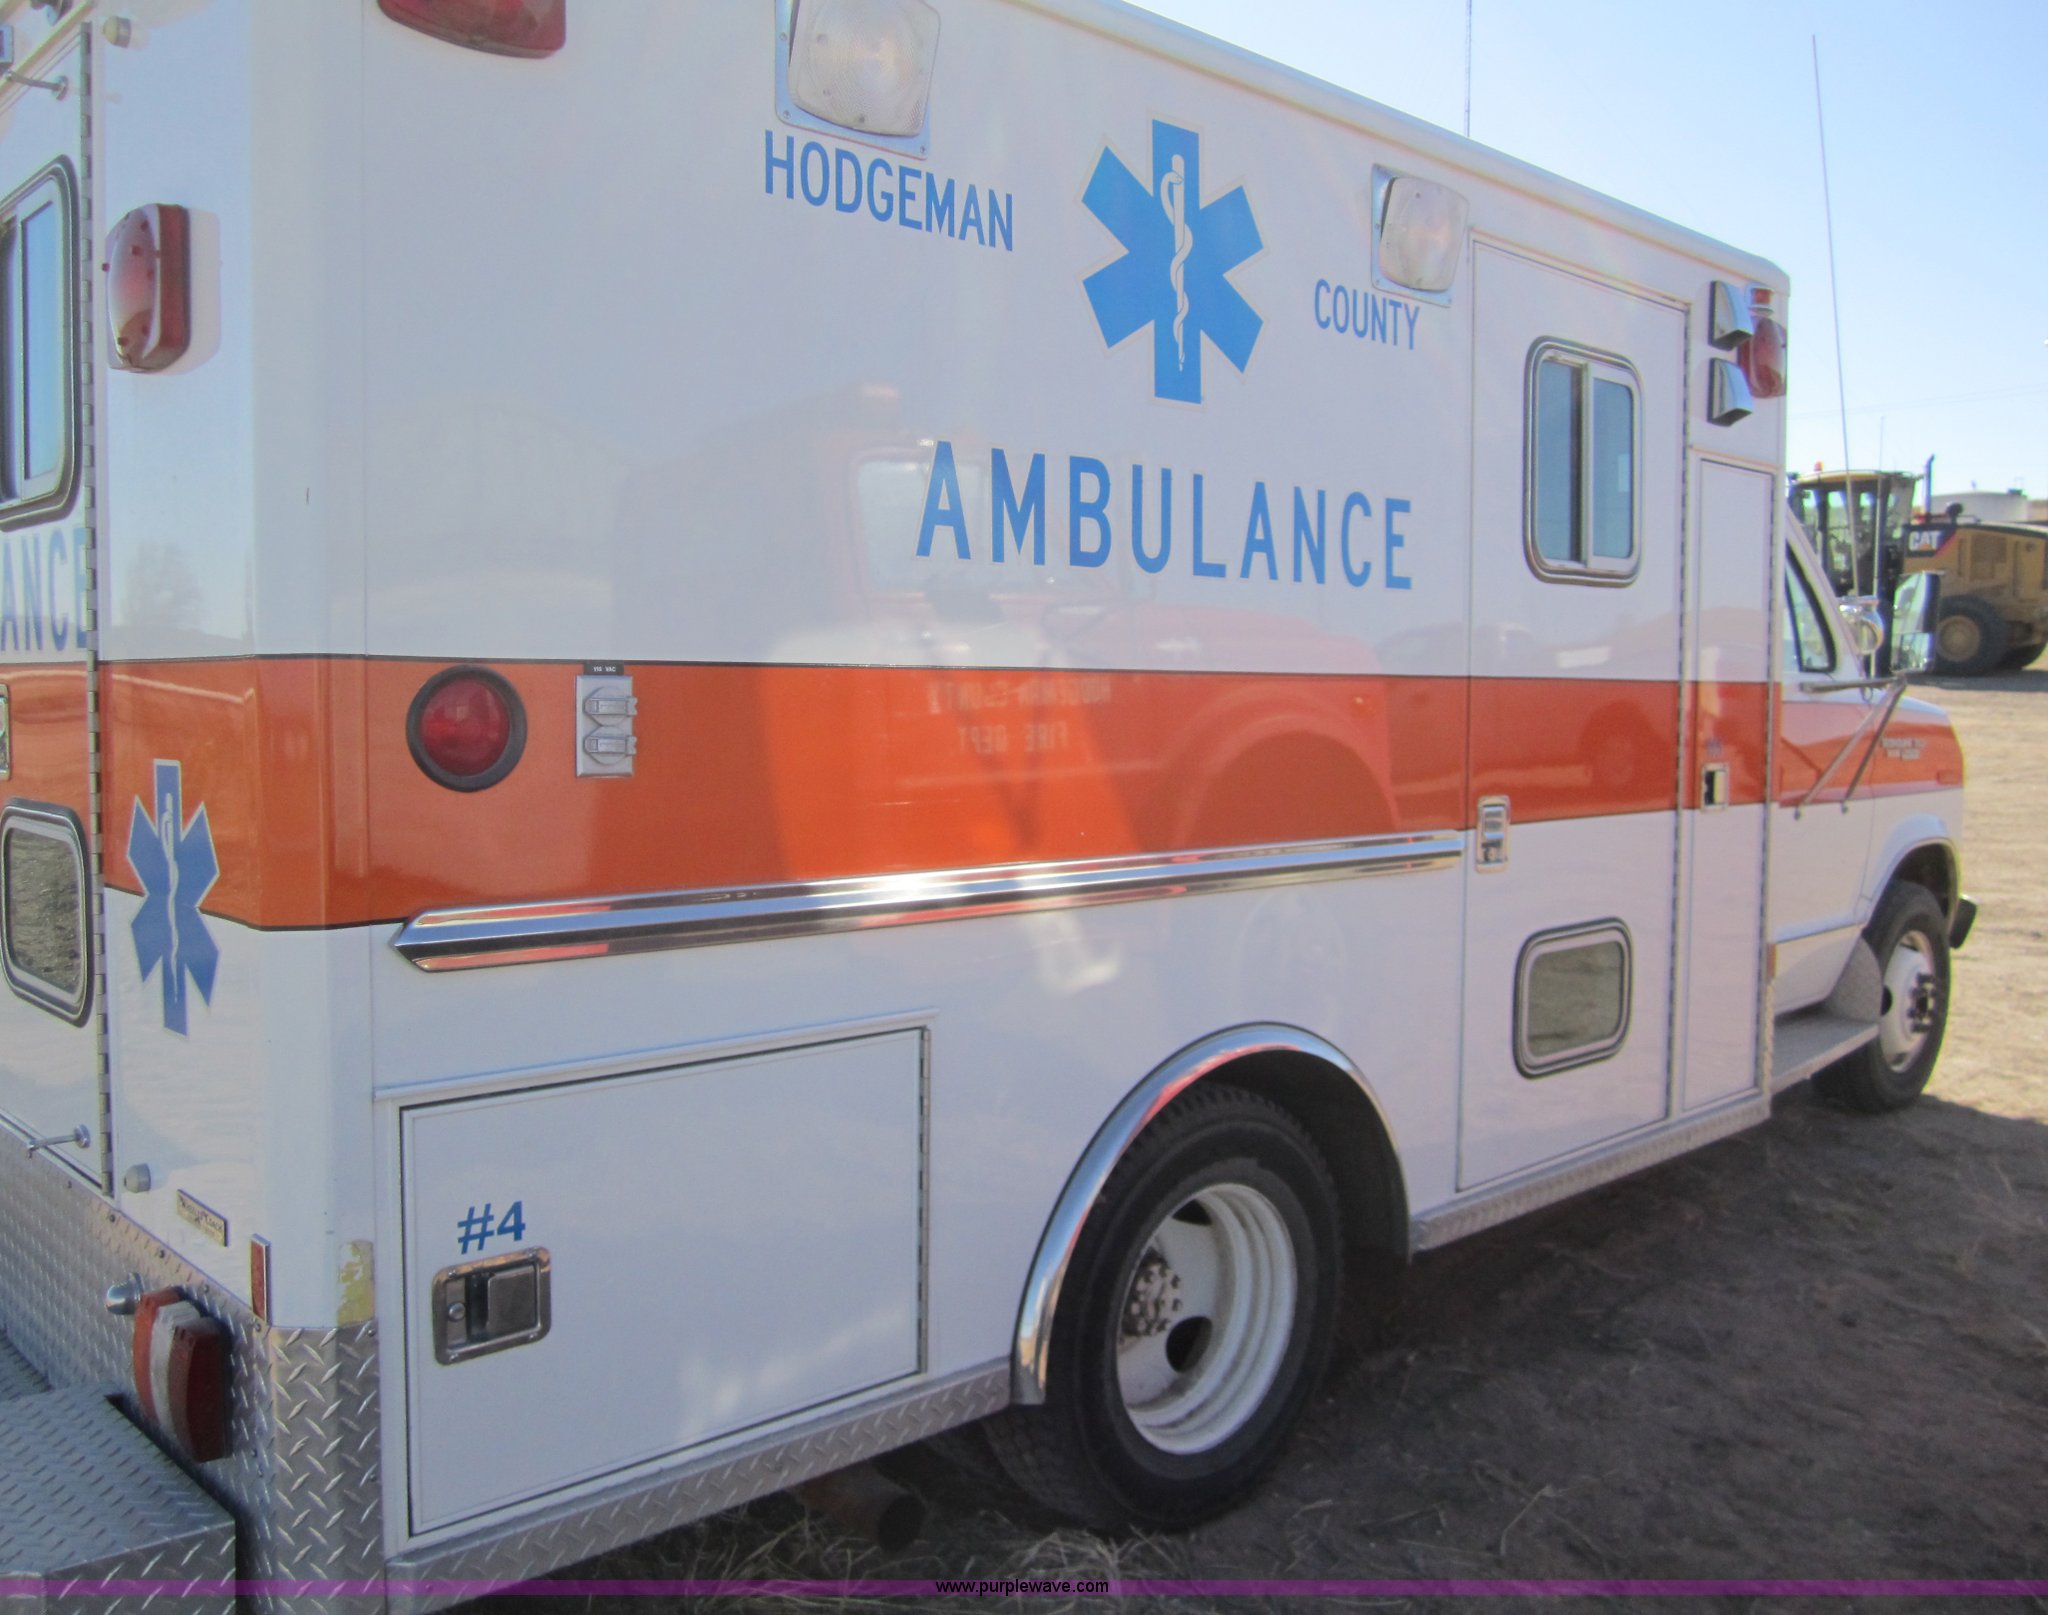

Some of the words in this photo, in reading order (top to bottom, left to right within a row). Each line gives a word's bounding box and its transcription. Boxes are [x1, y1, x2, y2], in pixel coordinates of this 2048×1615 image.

[765, 129, 1013, 252] HODGEMAN
[1314, 278, 1420, 351] COUNTY
[916, 440, 1412, 590] AMBULANCE
[1909, 531, 1941, 551] CAT
[457, 1200, 526, 1254] #4
